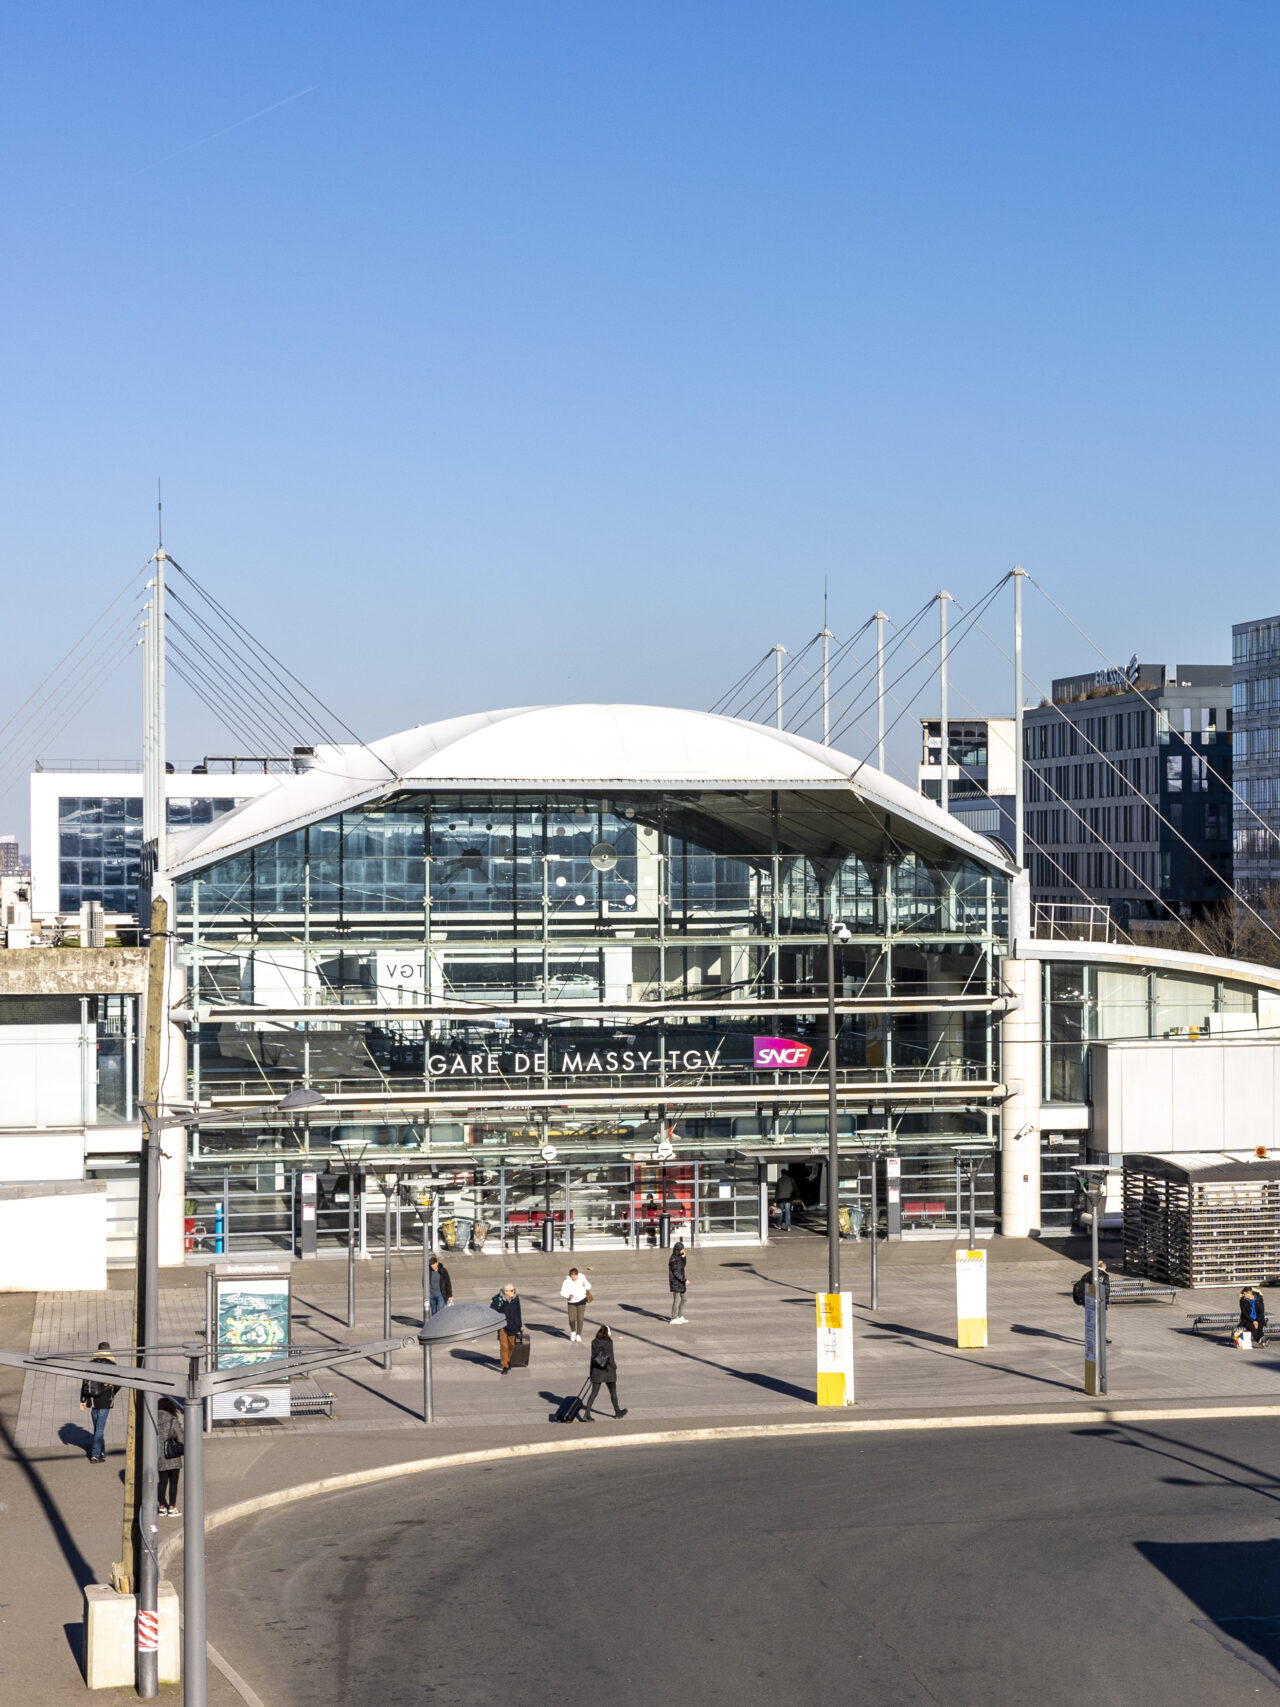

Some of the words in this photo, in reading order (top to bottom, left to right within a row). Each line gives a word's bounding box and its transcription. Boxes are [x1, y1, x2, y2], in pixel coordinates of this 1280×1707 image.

[1095, 664, 1128, 687] ERICSSON
[427, 1053, 500, 1075] GARE
[515, 1053, 546, 1073] DE
[561, 1051, 653, 1072] MASSY
[668, 1050, 721, 1070] TGV
[756, 1048, 808, 1065] SNCF
[226, 1264, 279, 1273] Informations
